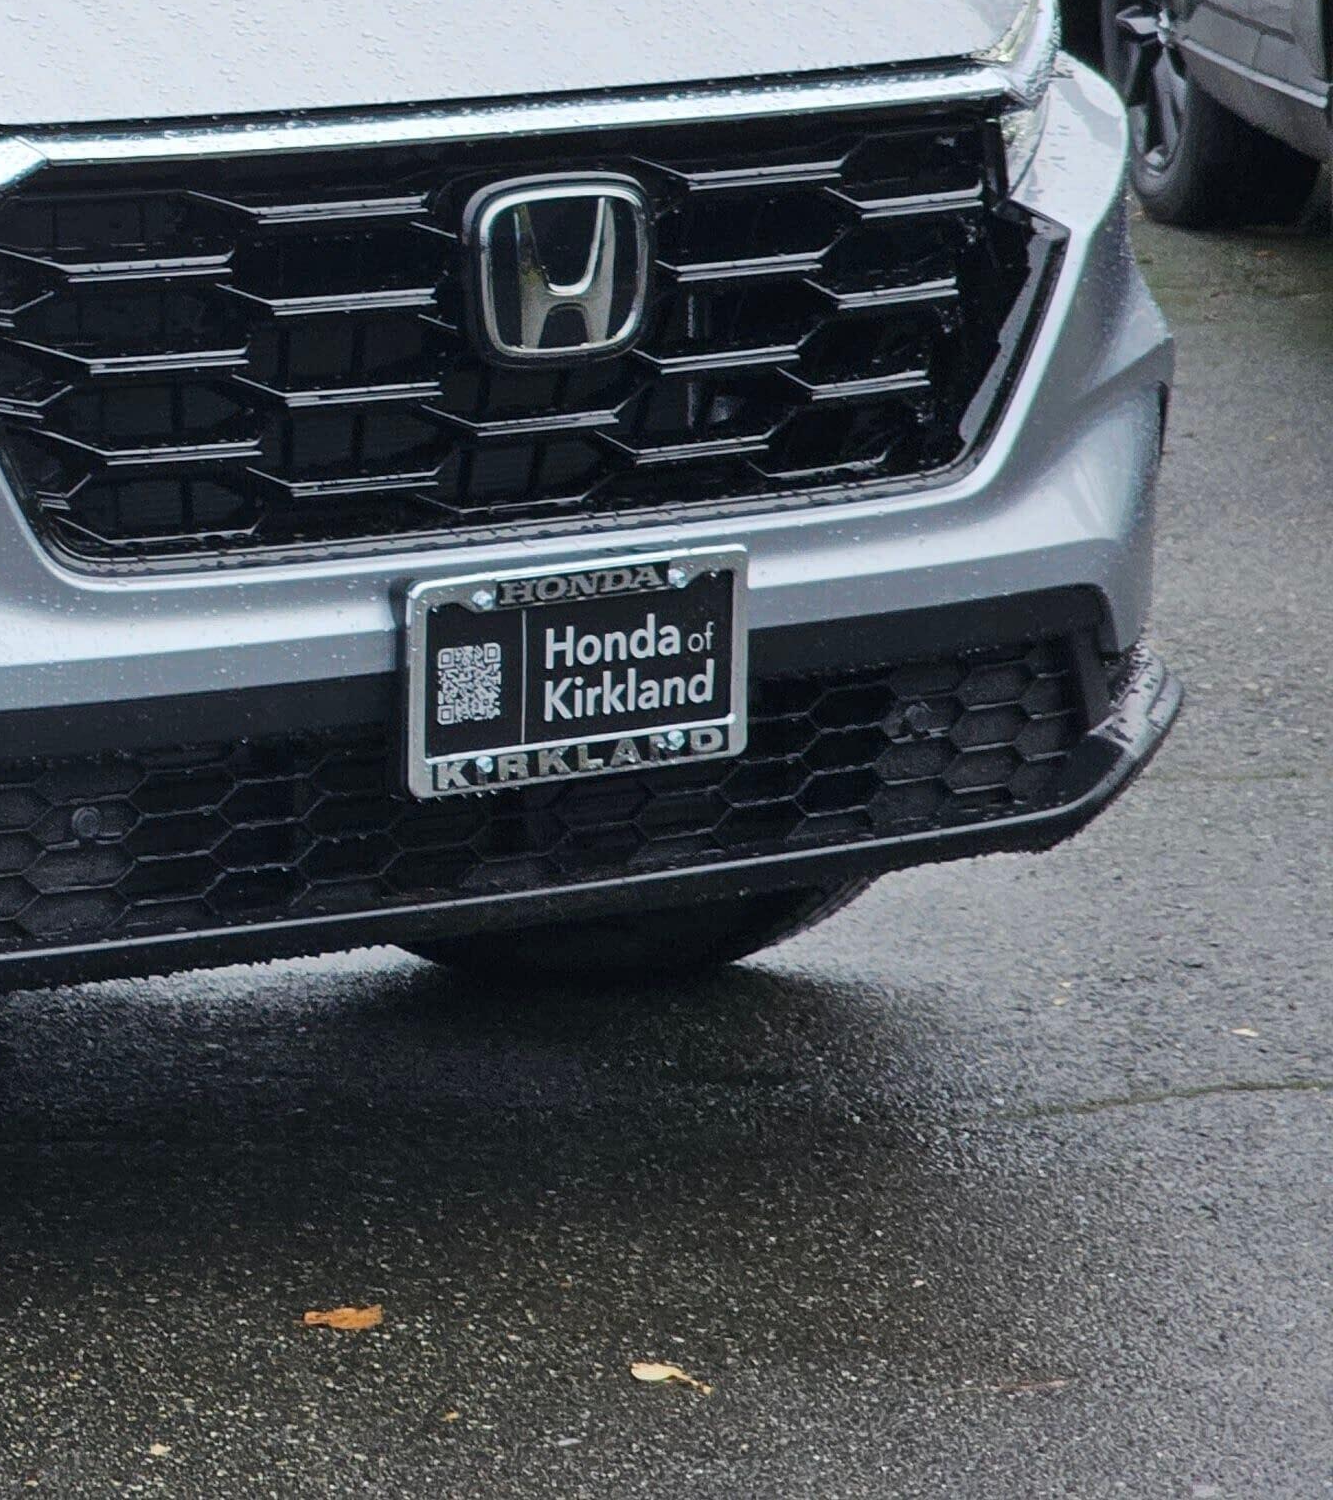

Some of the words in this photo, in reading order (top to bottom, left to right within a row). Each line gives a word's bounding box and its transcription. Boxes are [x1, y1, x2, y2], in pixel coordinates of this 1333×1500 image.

[499, 564, 664, 604] HONDA
[545, 613, 681, 670] Honda
[687, 621, 715, 653] of
[543, 658, 715, 723] Kirkland
